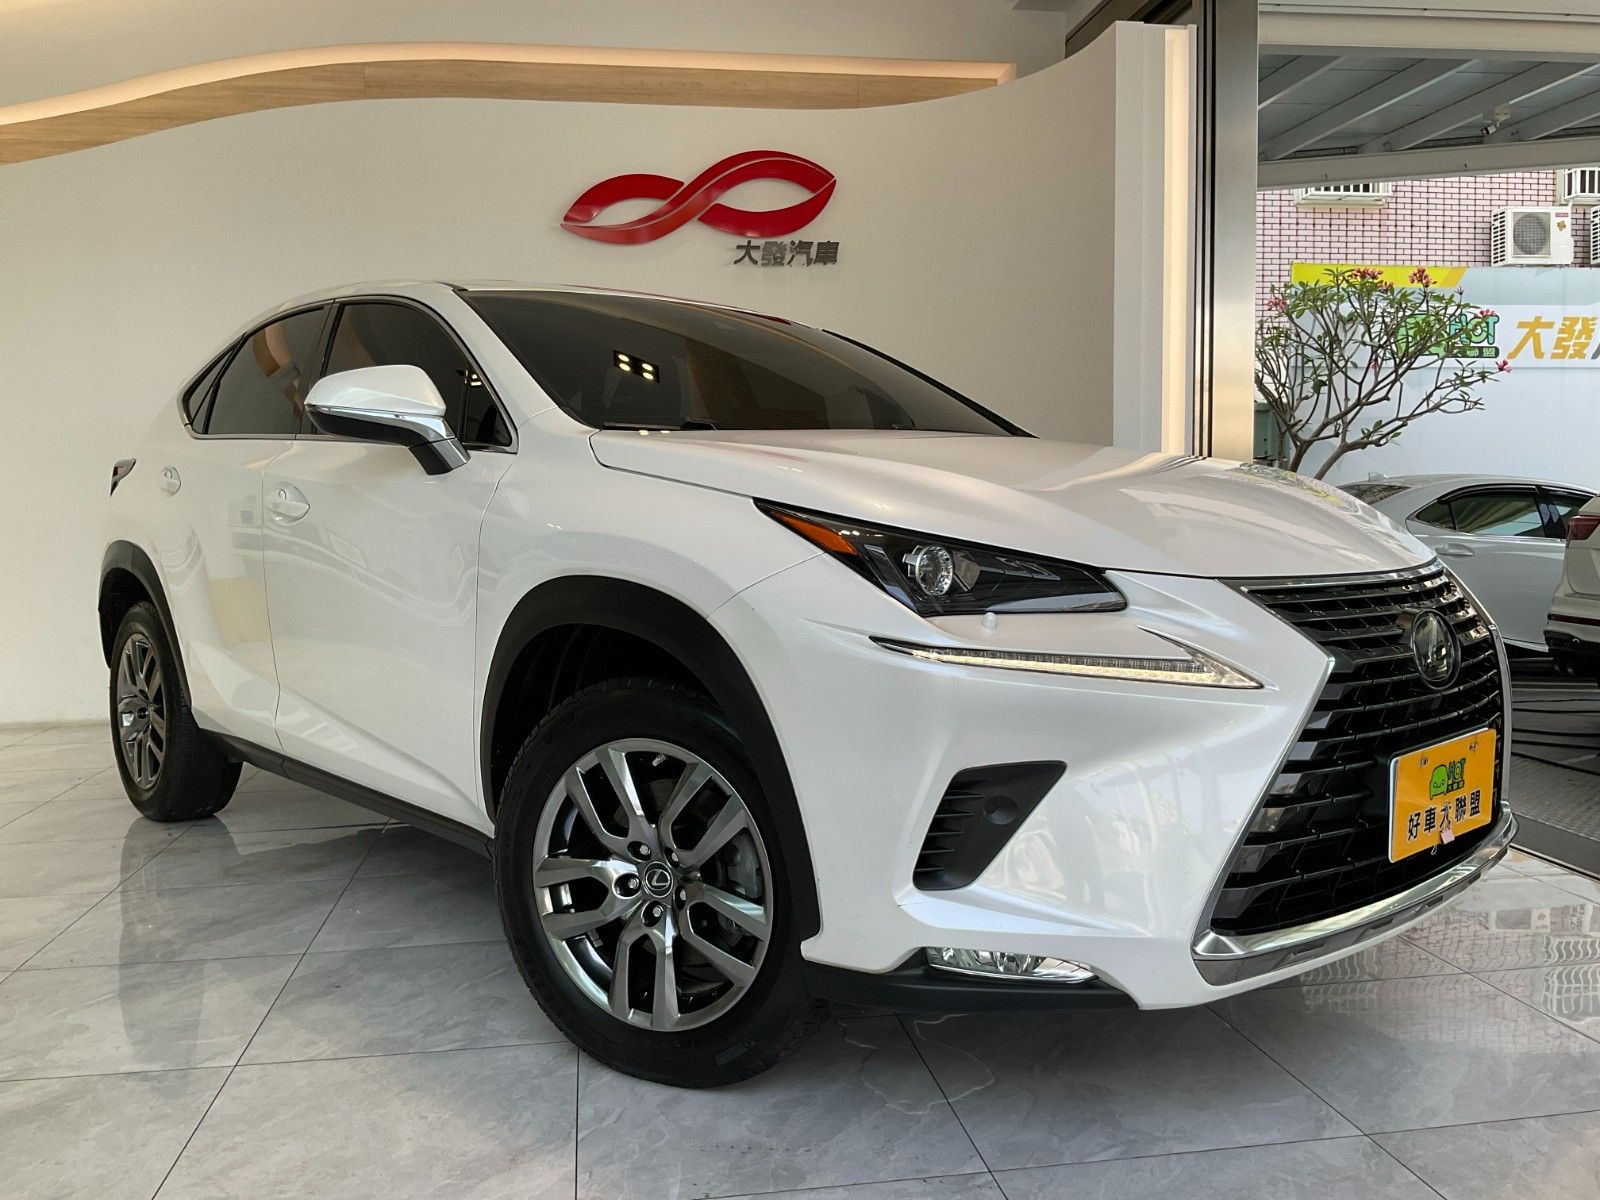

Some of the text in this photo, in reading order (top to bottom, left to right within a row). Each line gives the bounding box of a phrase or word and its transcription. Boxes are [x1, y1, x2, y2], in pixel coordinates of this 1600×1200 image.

[733, 239, 840, 267] 大發汽車
[1506, 315, 1600, 360] 大發
[1407, 789, 1481, 840] 好車大聯盟
